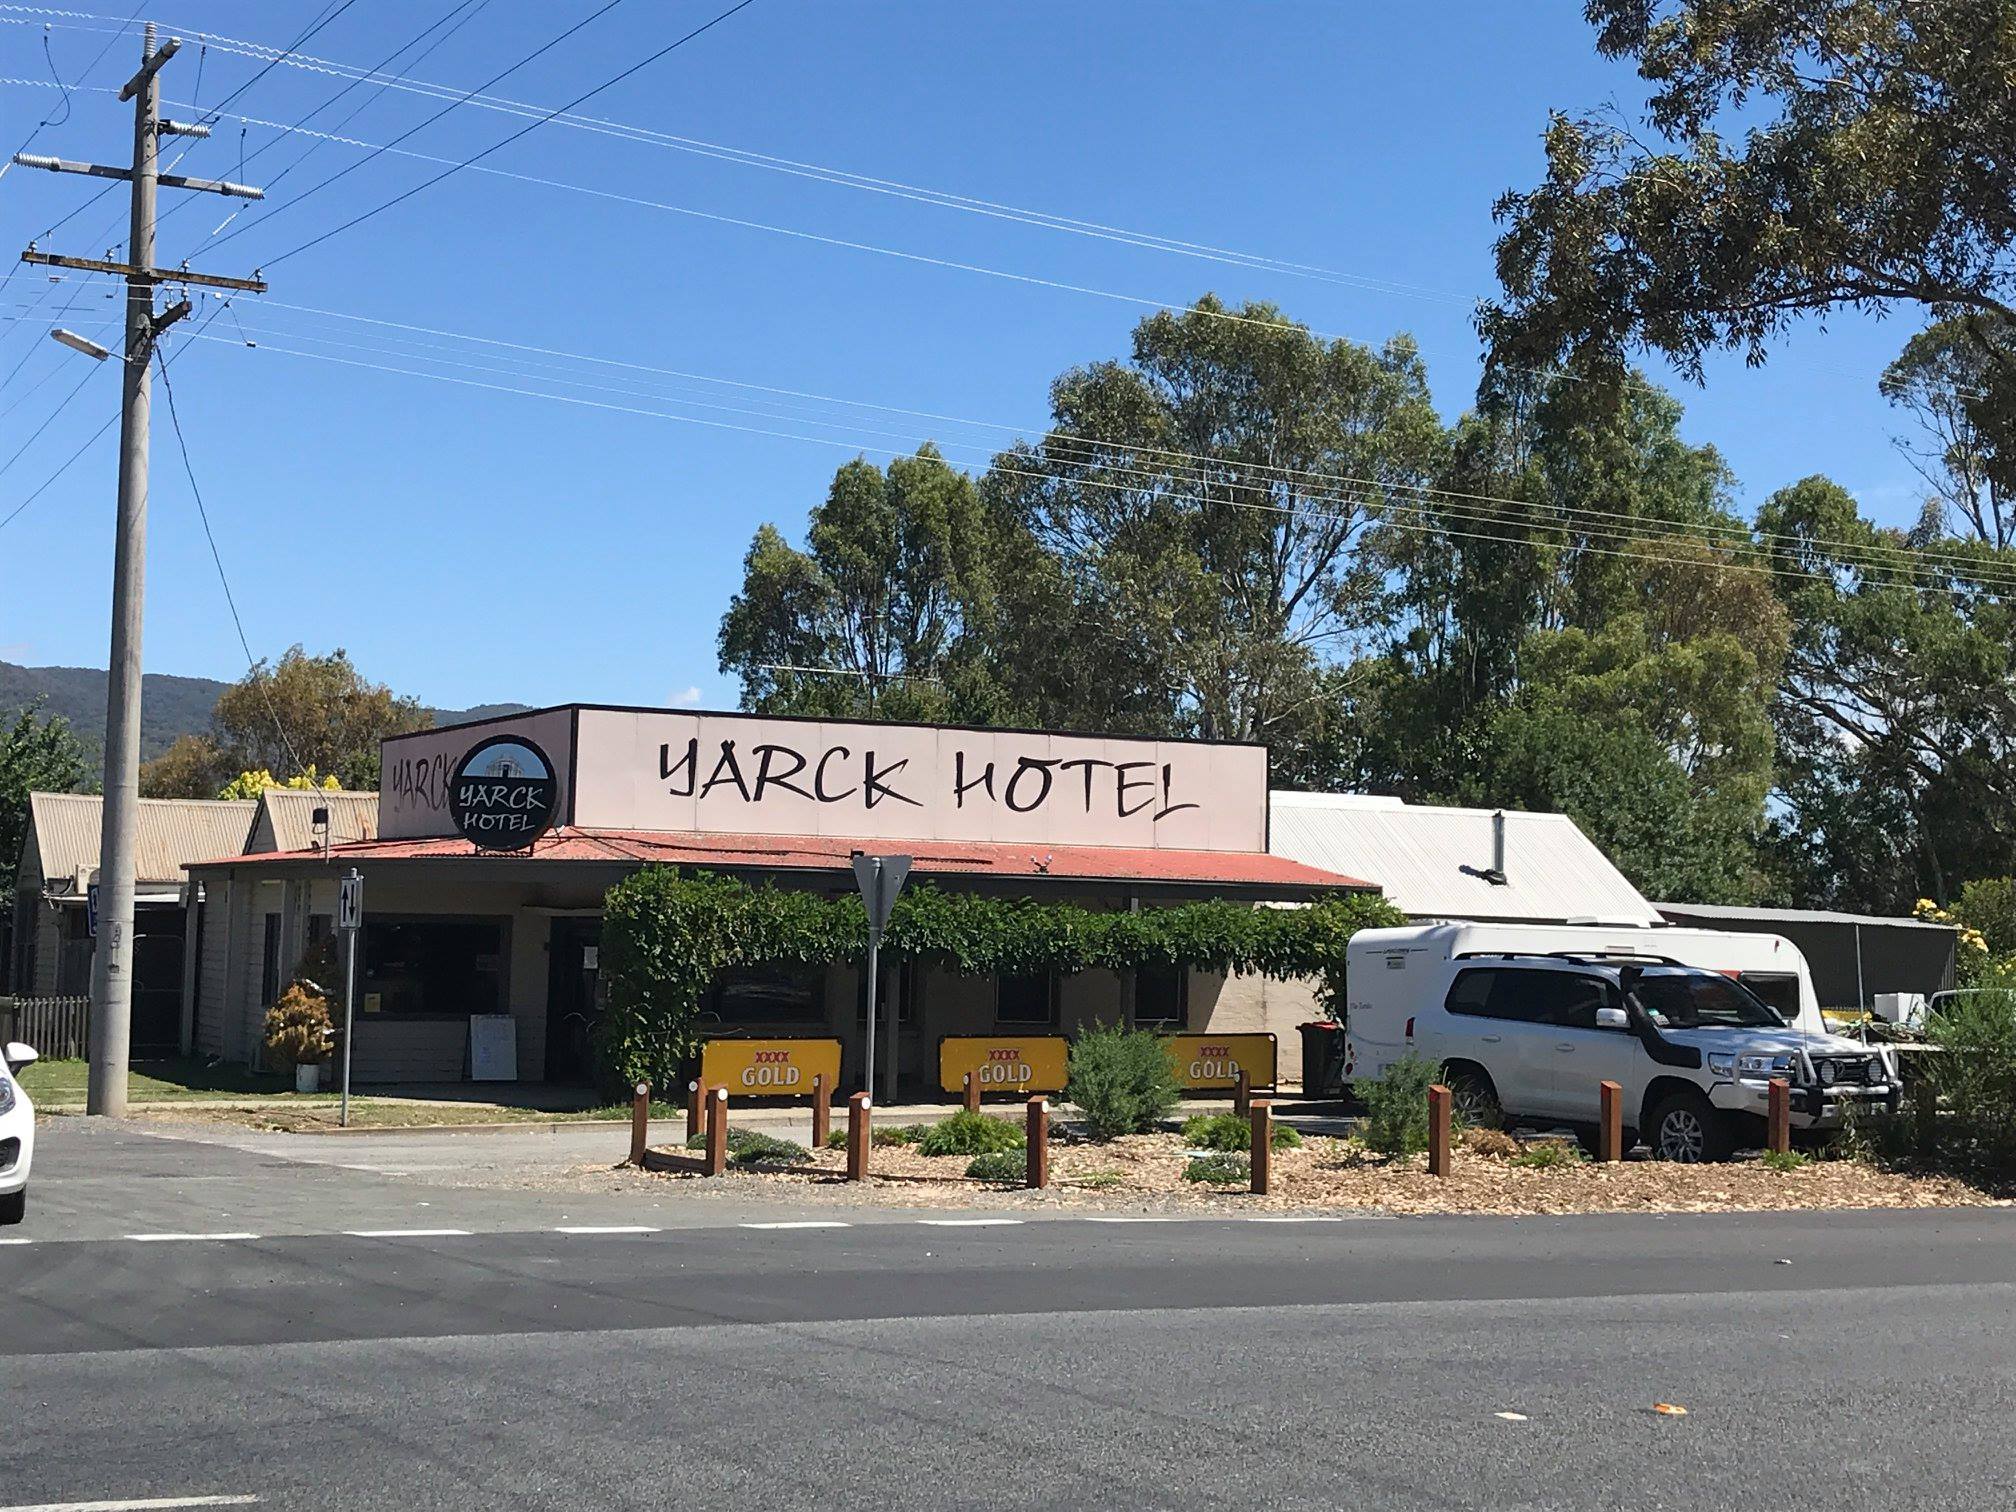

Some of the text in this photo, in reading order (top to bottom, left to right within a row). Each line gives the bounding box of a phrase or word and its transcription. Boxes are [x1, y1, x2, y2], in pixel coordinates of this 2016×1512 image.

[660, 737, 1200, 822] YARCK HOTEL
[459, 784, 547, 809] YARCK
[464, 812, 536, 831] HOTEL
[755, 1051, 790, 1063] XXXX
[988, 1049, 1020, 1061] XXXX
[1199, 1046, 1230, 1057] XXXX
[741, 1066, 800, 1086] GOLD
[979, 1064, 1032, 1083] GOLD
[1189, 1060, 1239, 1079] GOLD
